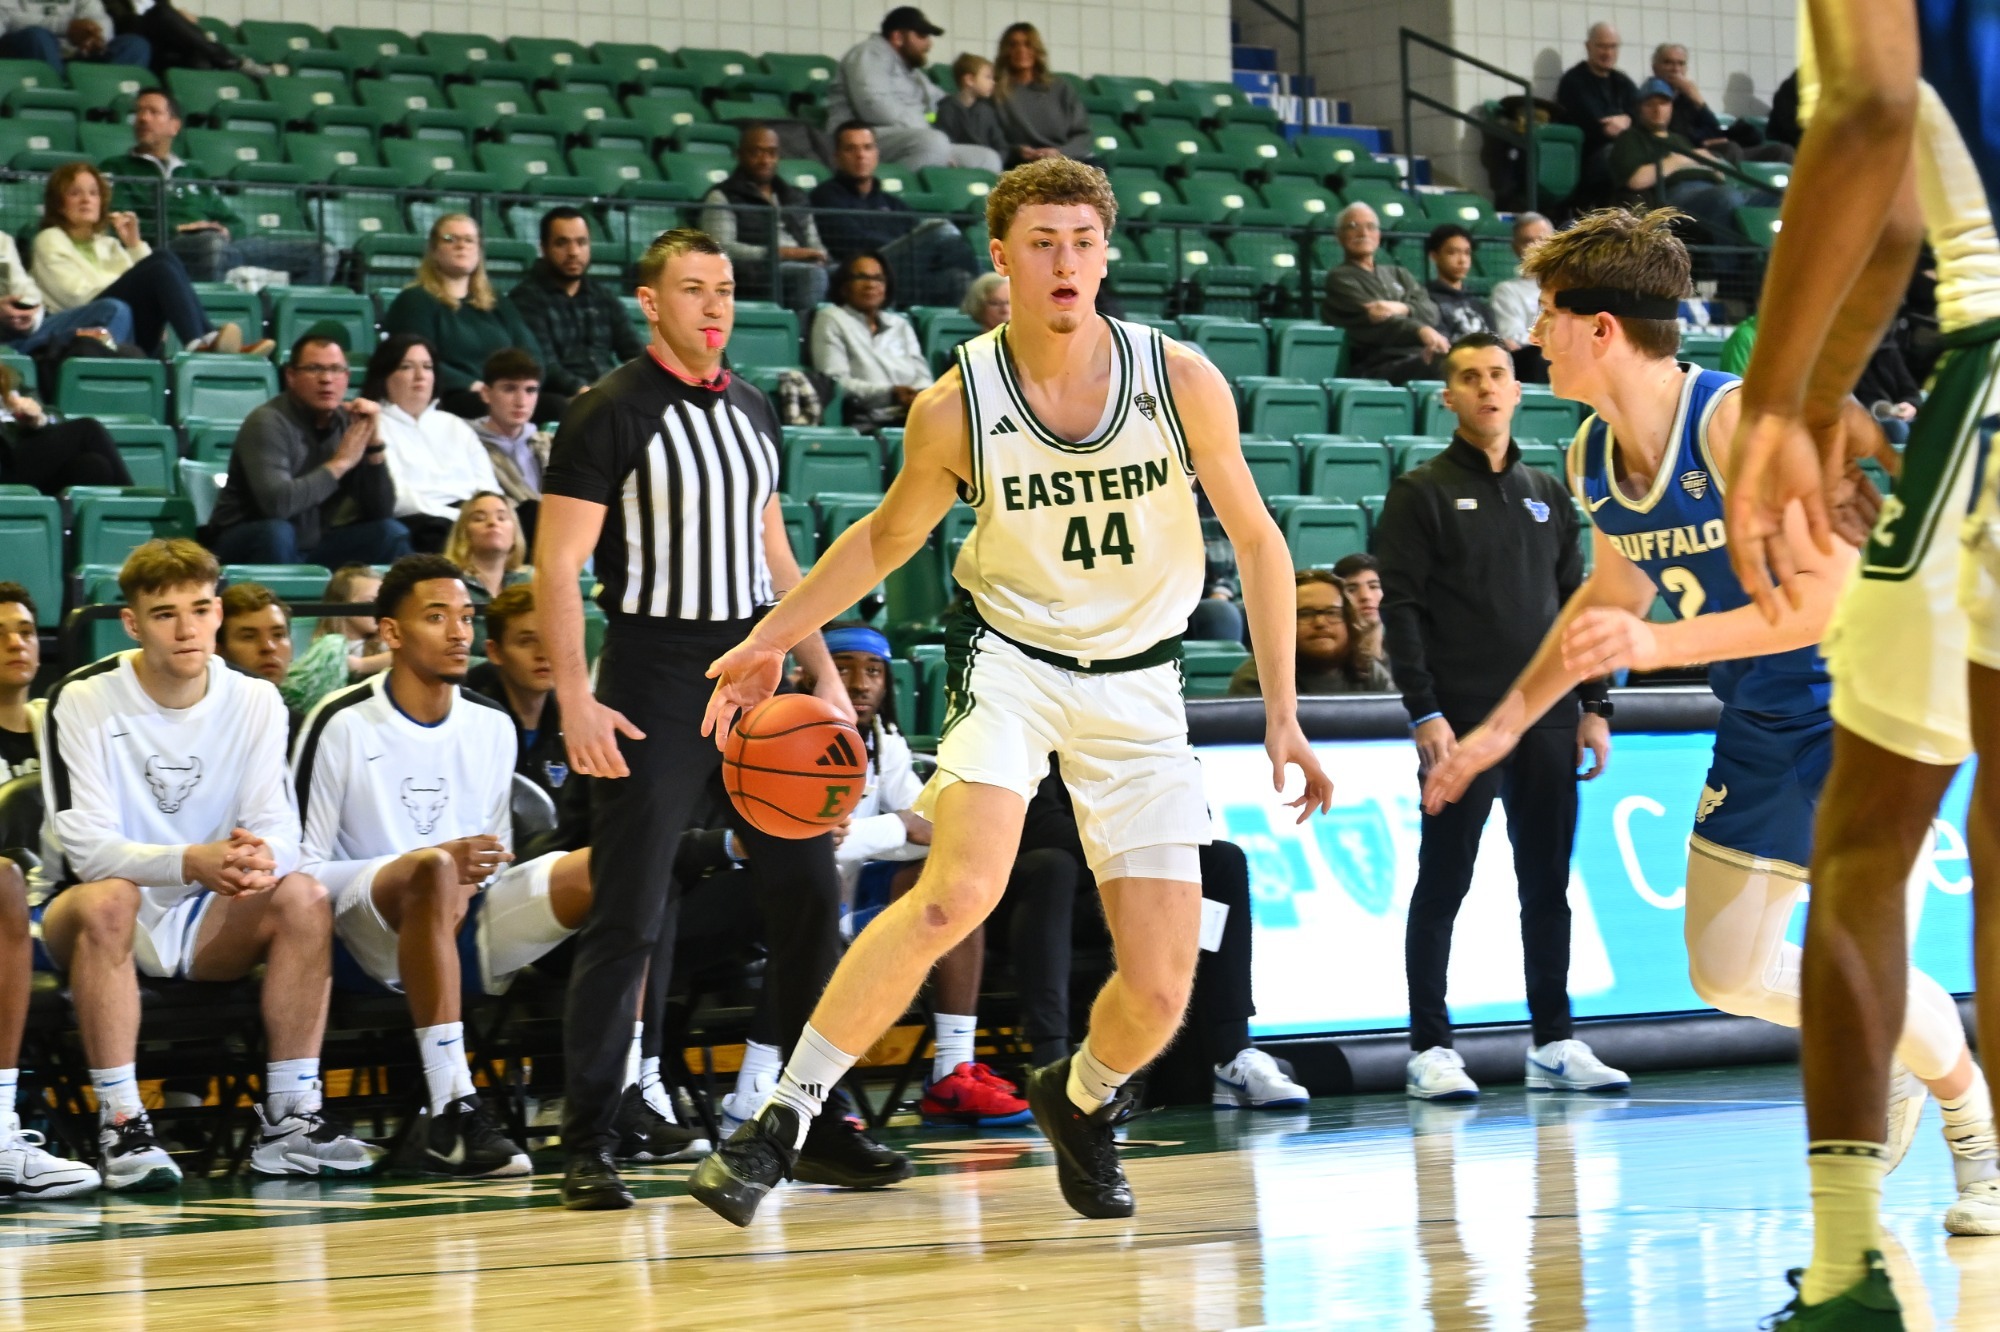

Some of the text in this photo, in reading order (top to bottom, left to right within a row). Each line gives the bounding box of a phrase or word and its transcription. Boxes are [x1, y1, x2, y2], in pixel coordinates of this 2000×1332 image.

[1002, 457, 1169, 511] EASTERN
[1062, 512, 1135, 570] 44
[1607, 518, 1727, 562] BUFFALO
[1660, 566, 1707, 619] 2
[816, 785, 850, 817] E
